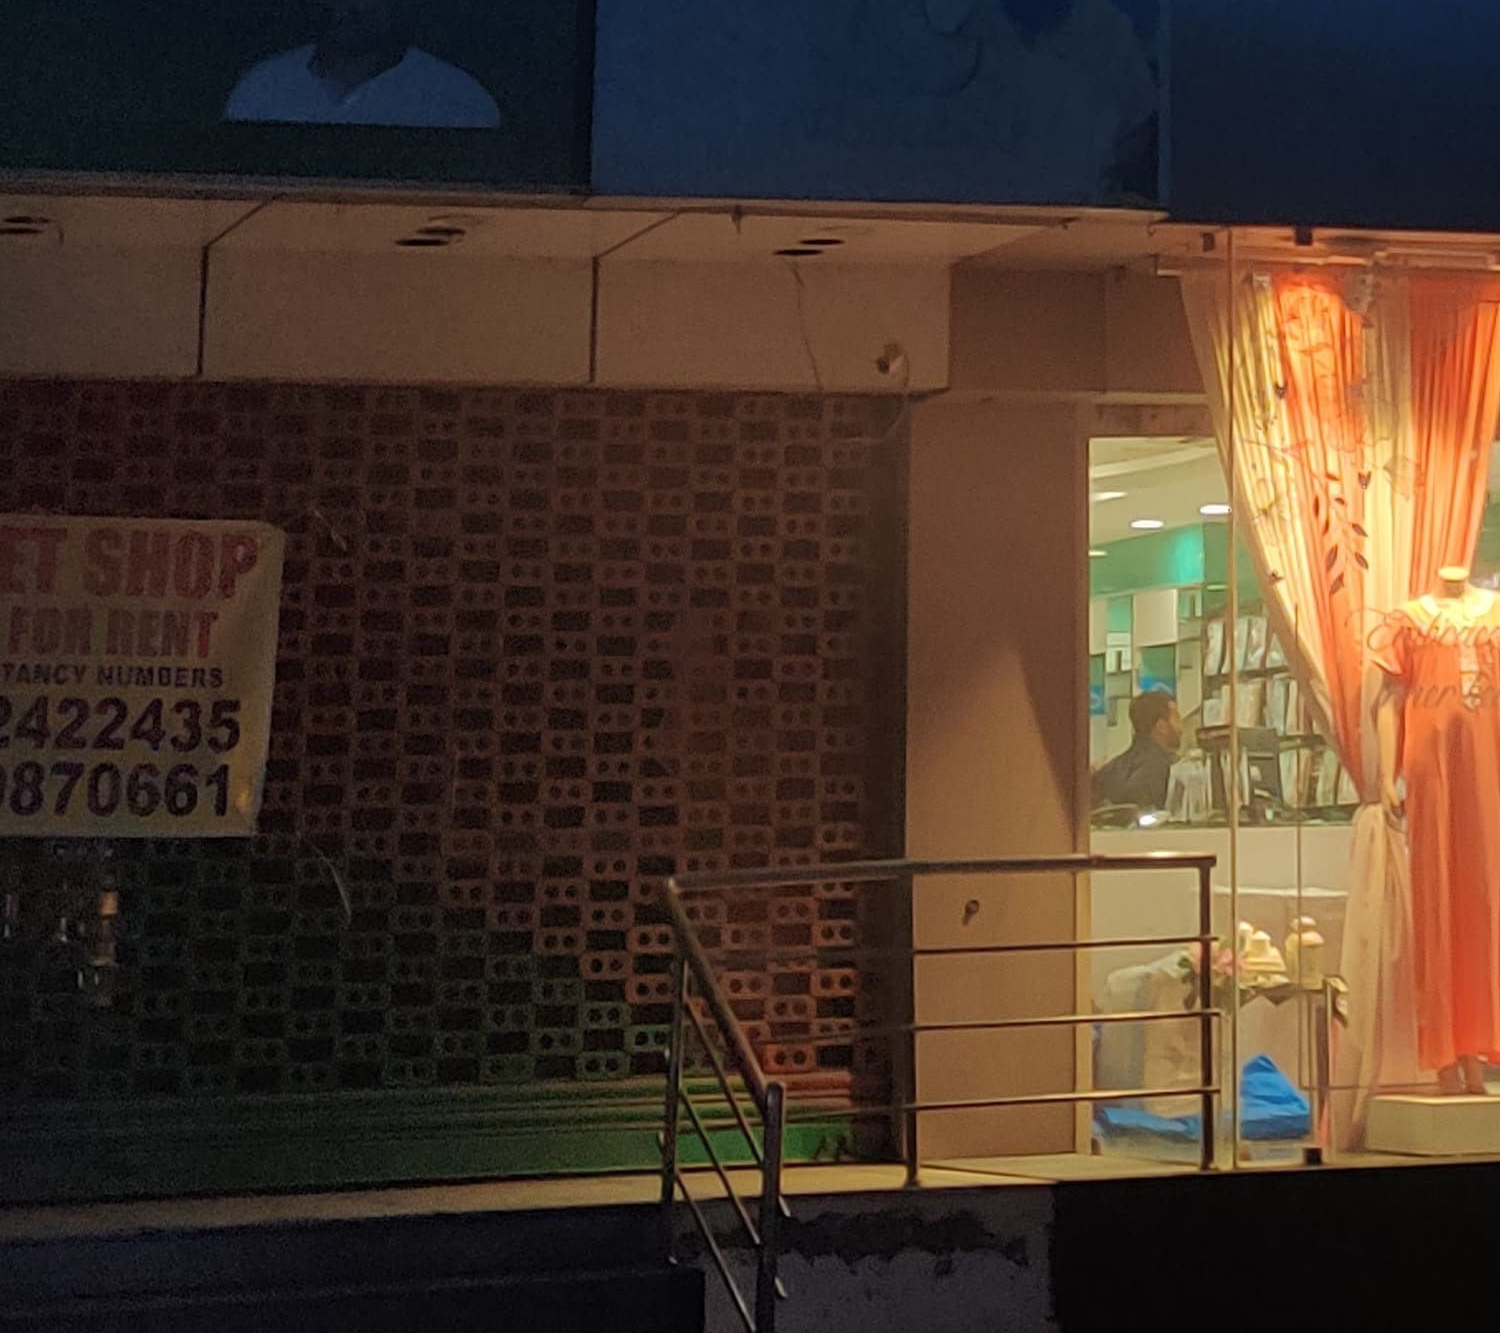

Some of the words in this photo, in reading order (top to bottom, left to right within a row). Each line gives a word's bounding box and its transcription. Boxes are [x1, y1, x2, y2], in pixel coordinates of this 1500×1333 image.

[84, 530, 258, 599] SHOP
[8, 605, 92, 656] FOR
[105, 608, 219, 659] RENT
[98, 664, 224, 690] NUMBERS
[0, 760, 230, 819] 870661
